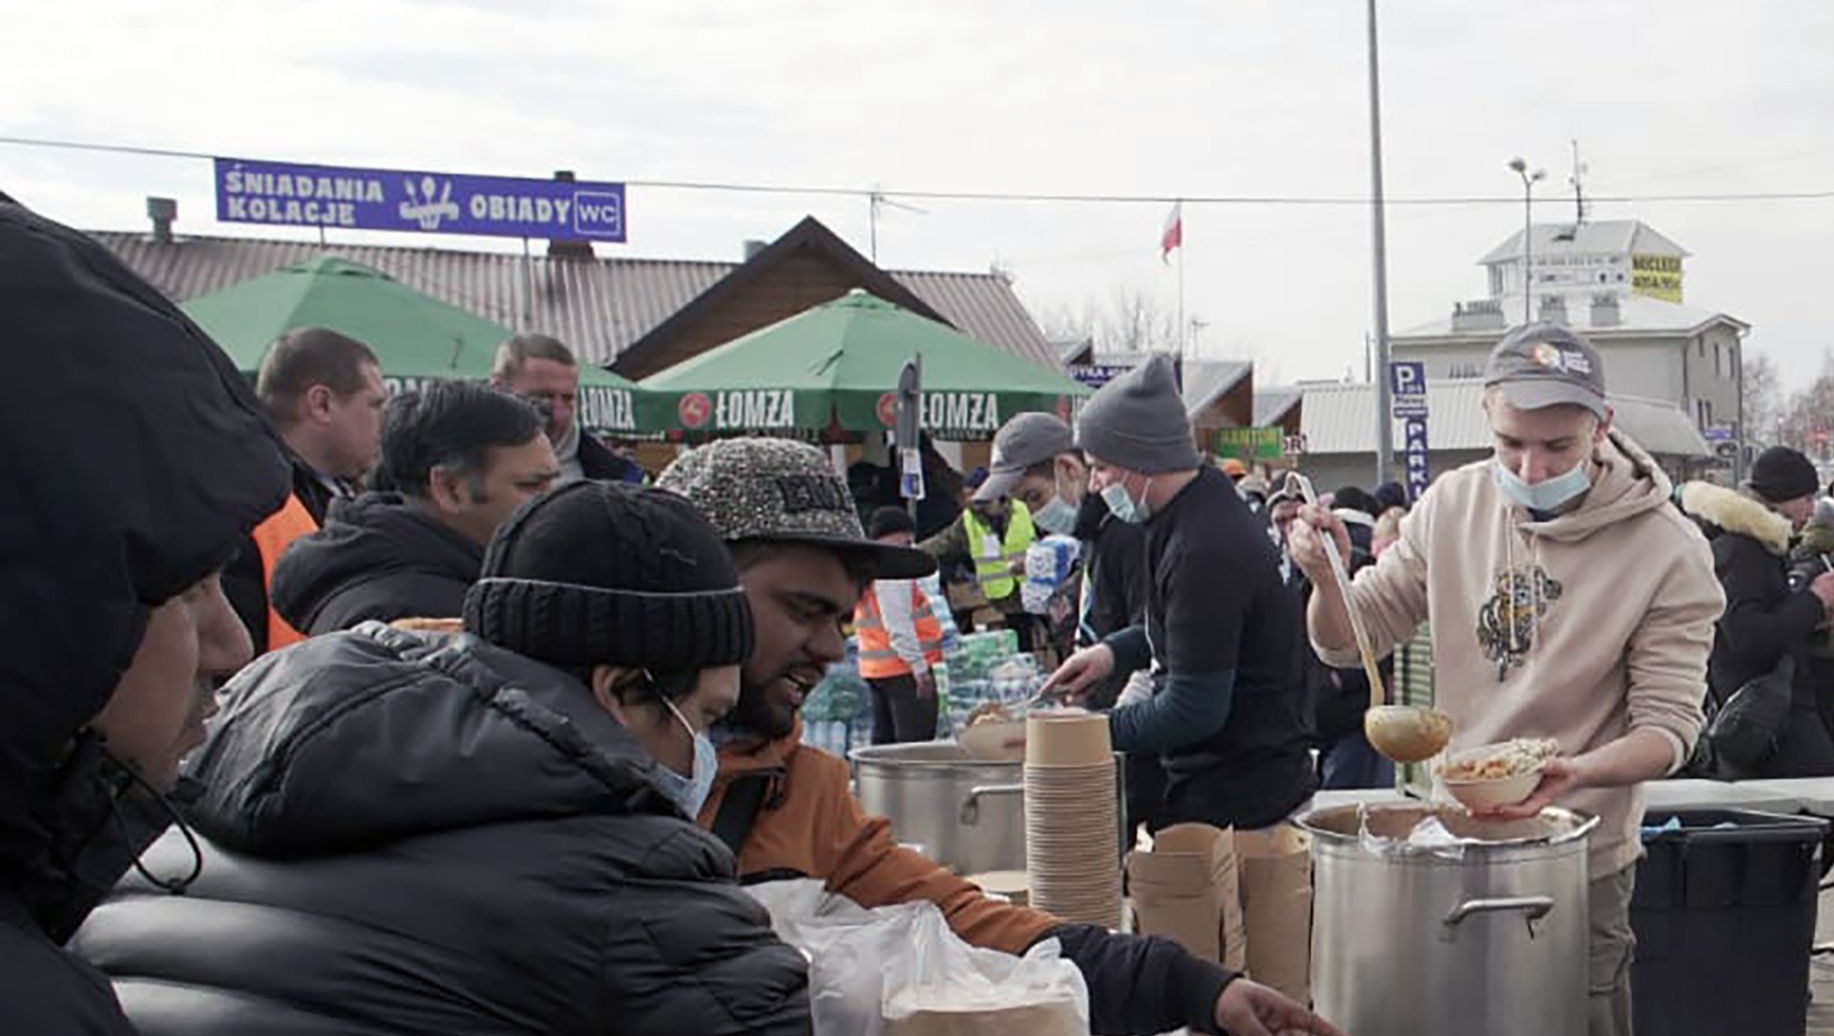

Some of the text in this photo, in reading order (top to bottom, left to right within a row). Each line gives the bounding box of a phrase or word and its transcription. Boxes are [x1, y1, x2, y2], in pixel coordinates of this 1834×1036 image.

[225, 164, 384, 202] ŚNIADANIA
[228, 197, 355, 225] KOLACJE
[470, 194, 571, 224] OBIADY
[579, 204, 616, 224] WC
[715, 390, 795, 429] ŁOMŻA
